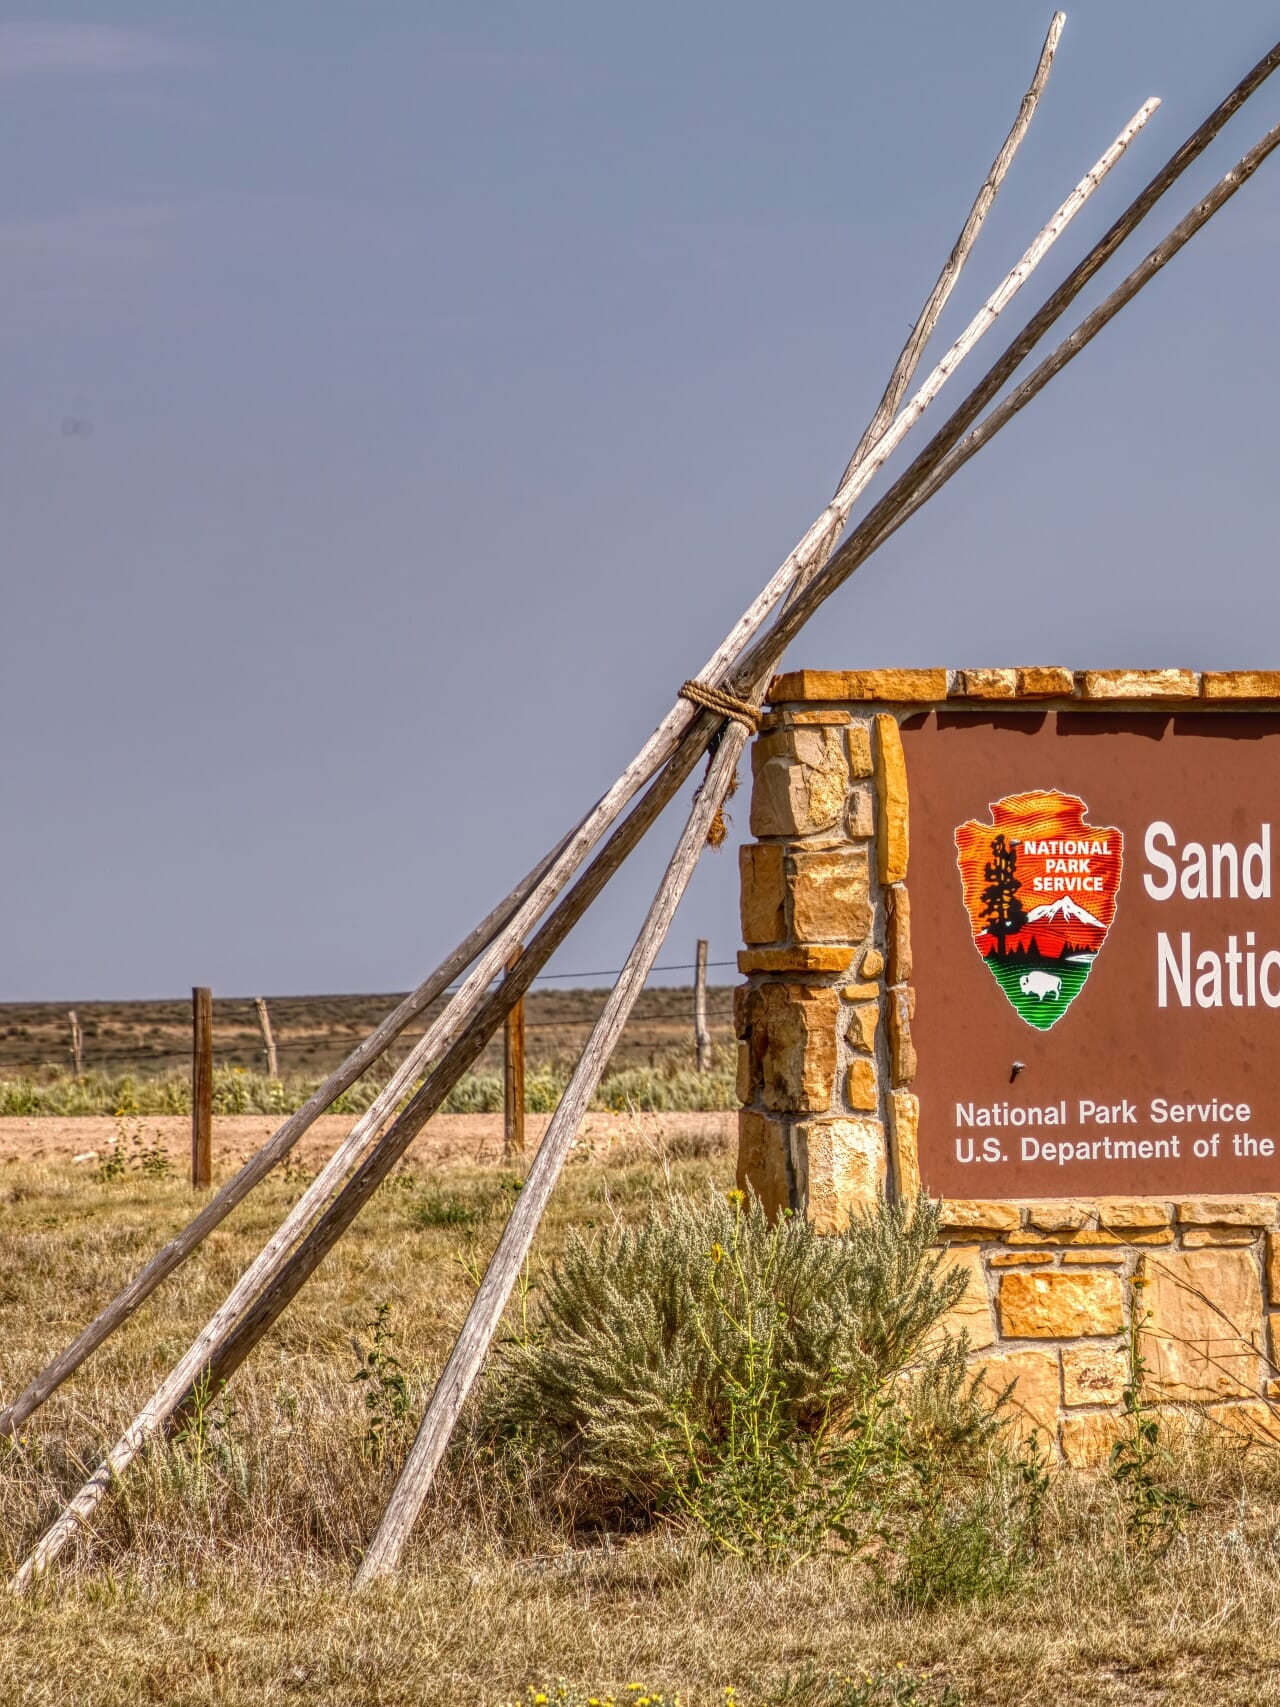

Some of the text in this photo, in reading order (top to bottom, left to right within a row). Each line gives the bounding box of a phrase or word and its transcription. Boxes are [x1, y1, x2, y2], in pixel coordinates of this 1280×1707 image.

[1023, 840, 1112, 856] NATIONAL
[1045, 858, 1091, 874] PARK
[1143, 820, 1272, 901] Sand
[1032, 876, 1104, 892] SERVICE
[955, 1098, 1251, 1127] National Park Service
[955, 1137, 1008, 1163] U.S.
[1021, 1135, 1181, 1166] Department
[1193, 1133, 1220, 1158] of
[1232, 1133, 1275, 1157] the
